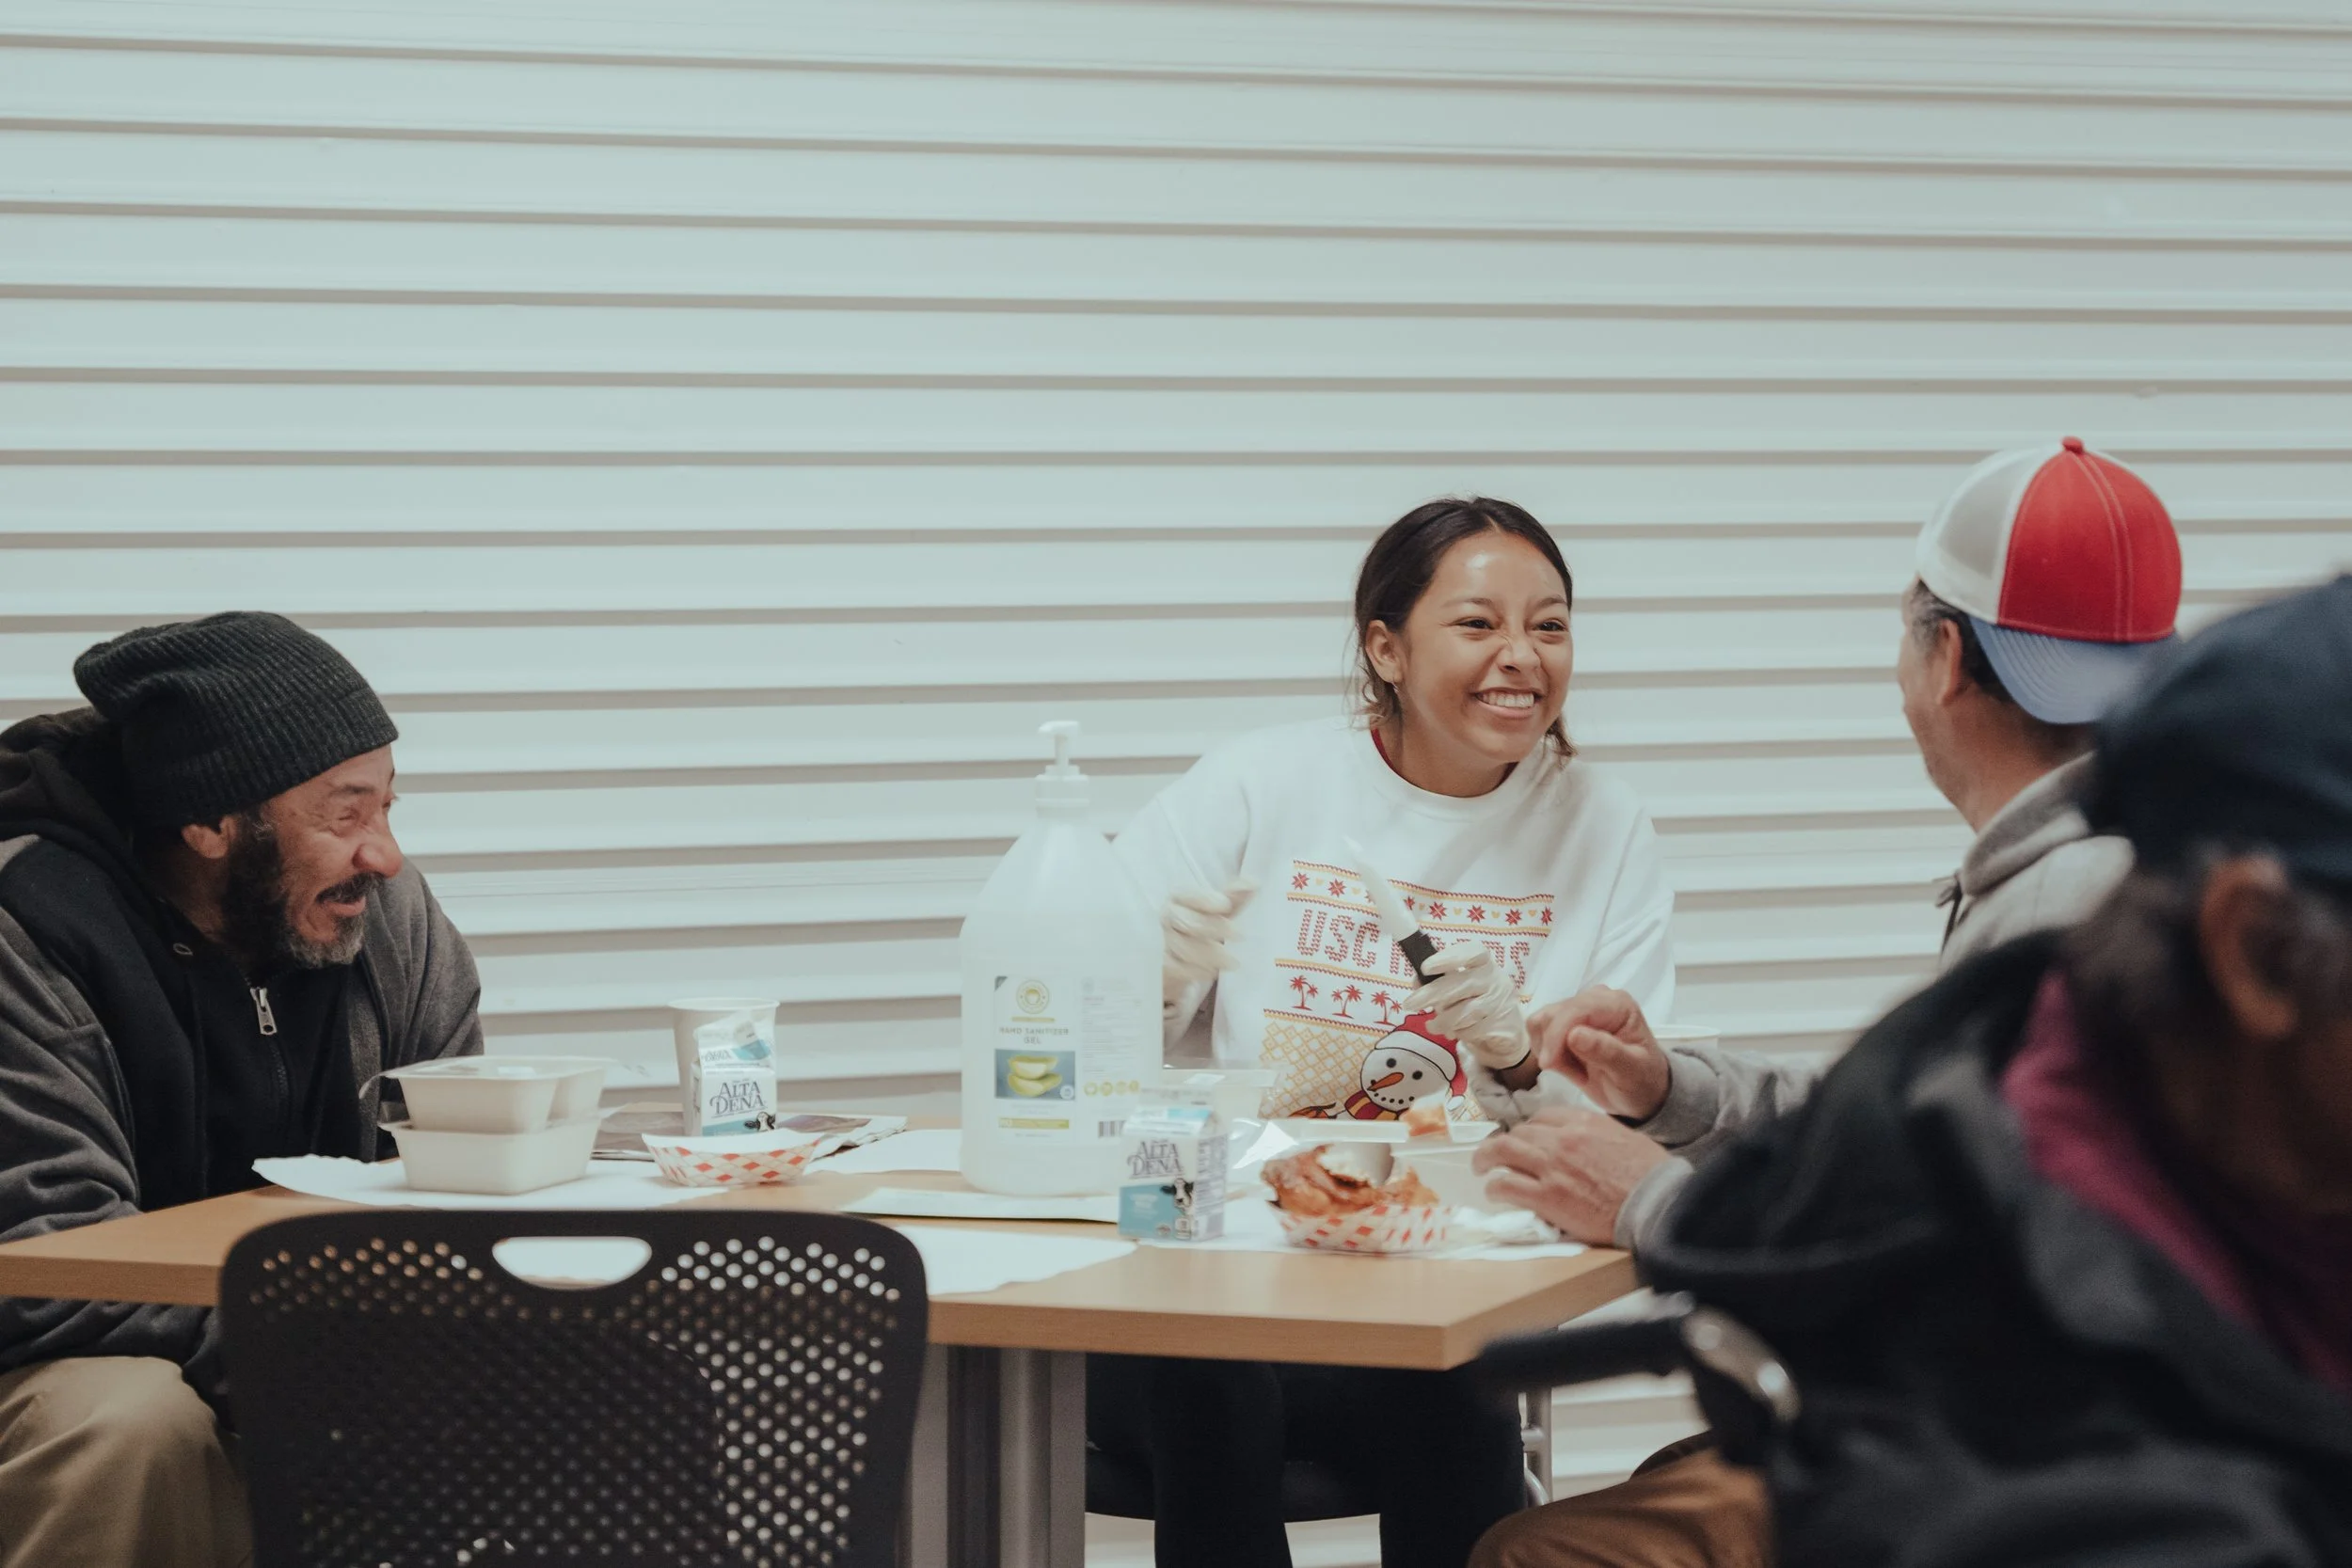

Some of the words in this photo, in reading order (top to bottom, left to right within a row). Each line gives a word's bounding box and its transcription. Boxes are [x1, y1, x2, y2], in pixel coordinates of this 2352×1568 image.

[1297, 909, 1380, 969] USC
[719, 1081, 761, 1099] ALTA
[709, 1094, 767, 1115] DENA
[1136, 1140, 1179, 1160] ALTA
[1126, 1154, 1184, 1176] DENA
